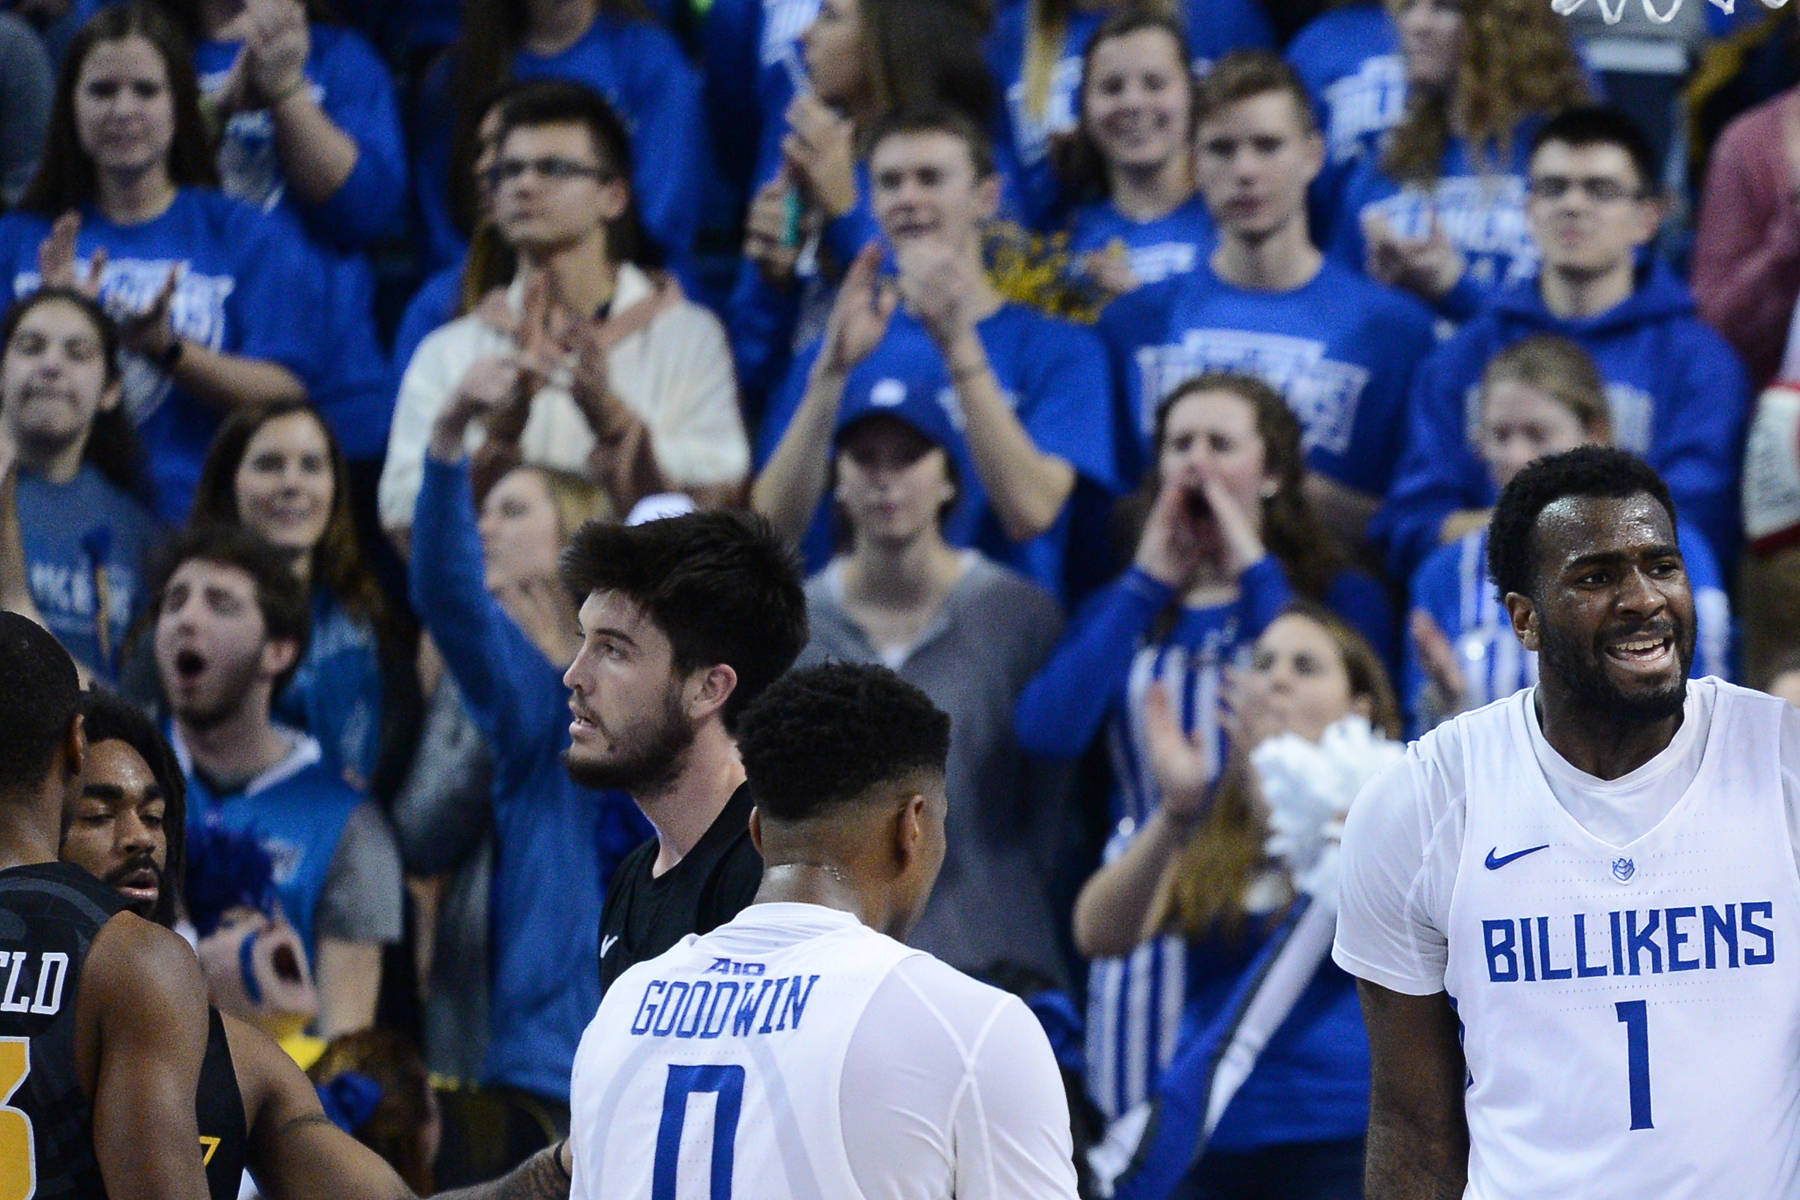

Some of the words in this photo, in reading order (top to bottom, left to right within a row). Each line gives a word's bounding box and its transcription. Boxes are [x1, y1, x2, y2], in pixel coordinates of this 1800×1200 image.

[1482, 901, 1775, 983] BILLIKENS
[0, 951, 69, 1015] LD
[630, 974, 821, 1039] GOODWIN
[1615, 1000, 1655, 1131] 1
